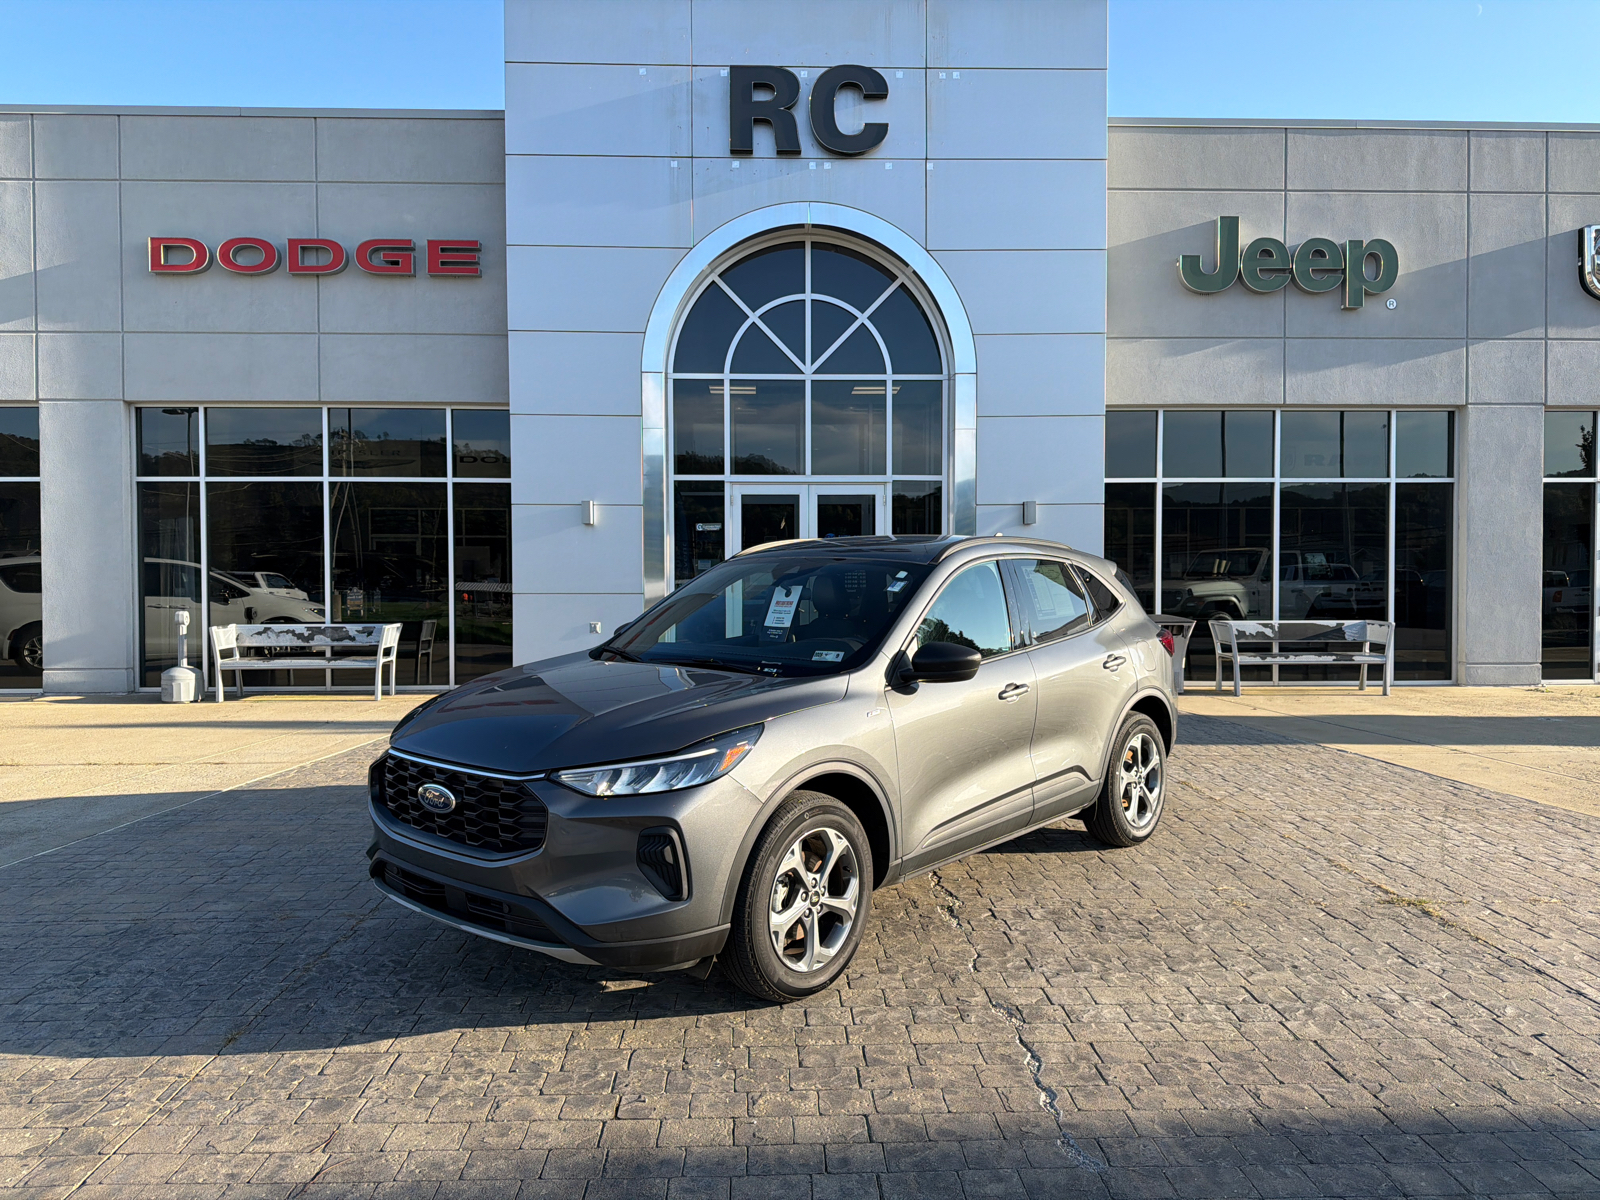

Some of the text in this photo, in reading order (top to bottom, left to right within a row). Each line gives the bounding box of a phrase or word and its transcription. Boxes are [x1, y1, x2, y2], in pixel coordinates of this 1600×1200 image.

[729, 64, 889, 157] RC
[148, 237, 482, 278] DODGE
[1176, 215, 1400, 310] Jeep
[424, 789, 445, 808] Ford
